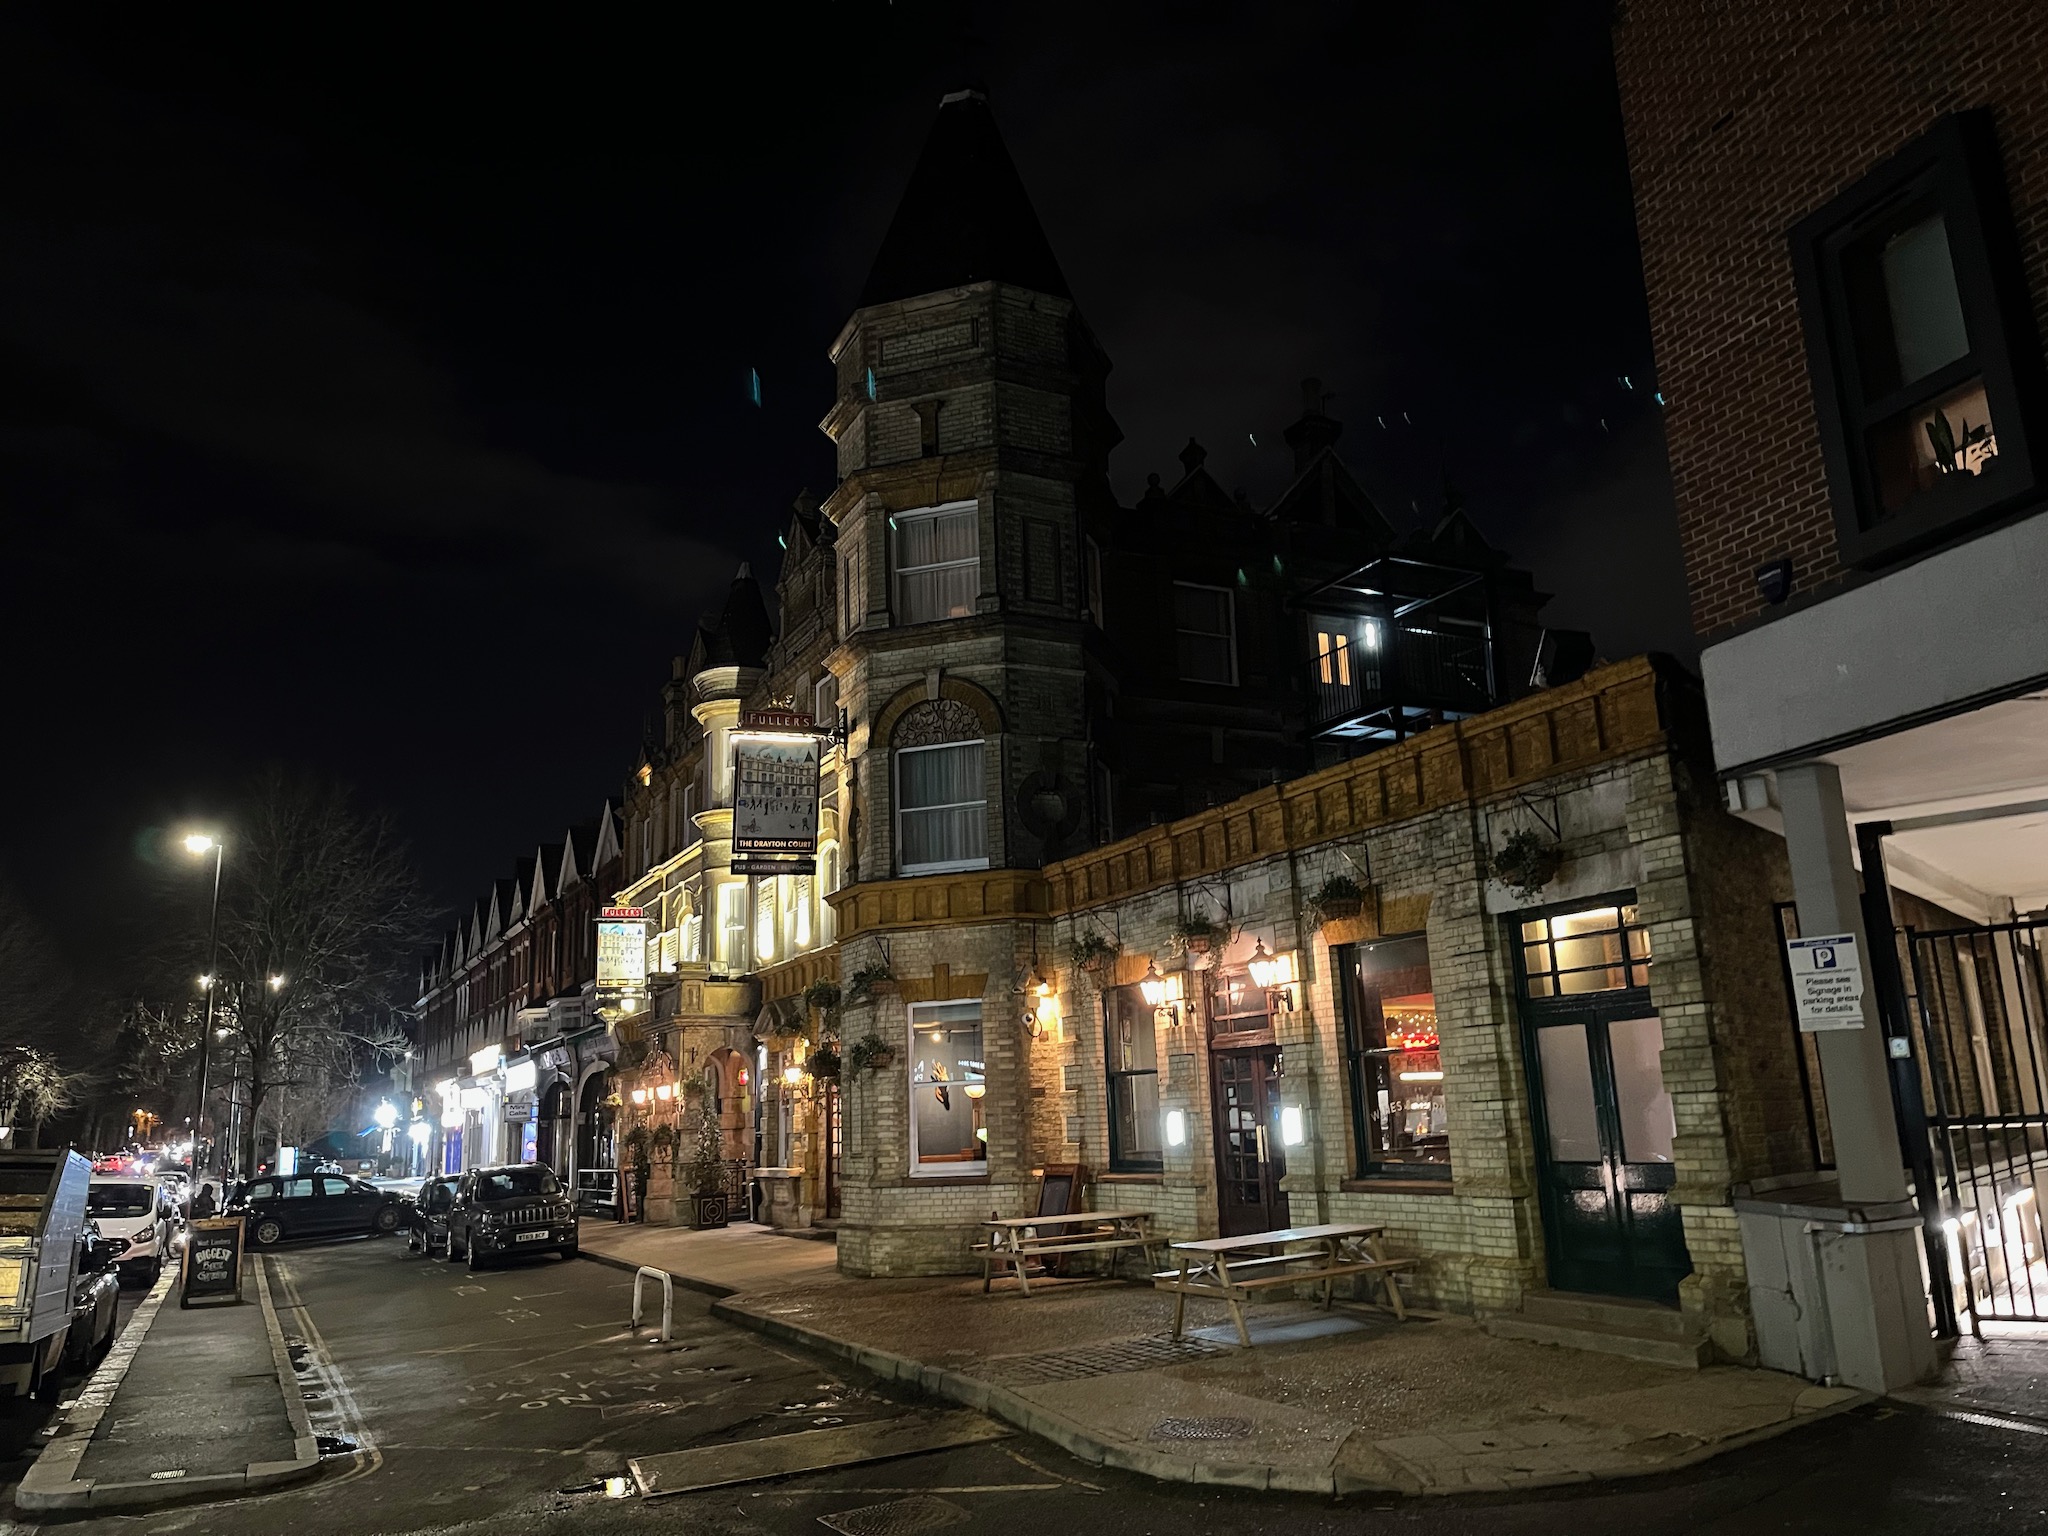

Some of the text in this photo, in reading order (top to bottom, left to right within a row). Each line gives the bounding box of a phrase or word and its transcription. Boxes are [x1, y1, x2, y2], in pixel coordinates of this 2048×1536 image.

[749, 713, 810, 727] FULLER'S
[753, 840, 786, 848] DRAYTON
[1806, 977, 1834, 986] Please
[1807, 985, 1852, 996] Signage in
[1802, 994, 1860, 1006] parking areas
[1811, 1004, 1854, 1014] for details
[1370, 1100, 1403, 1122] WNES
[195, 1248, 233, 1265] BIGGEST
[520, 1384, 659, 1410] ONLY
